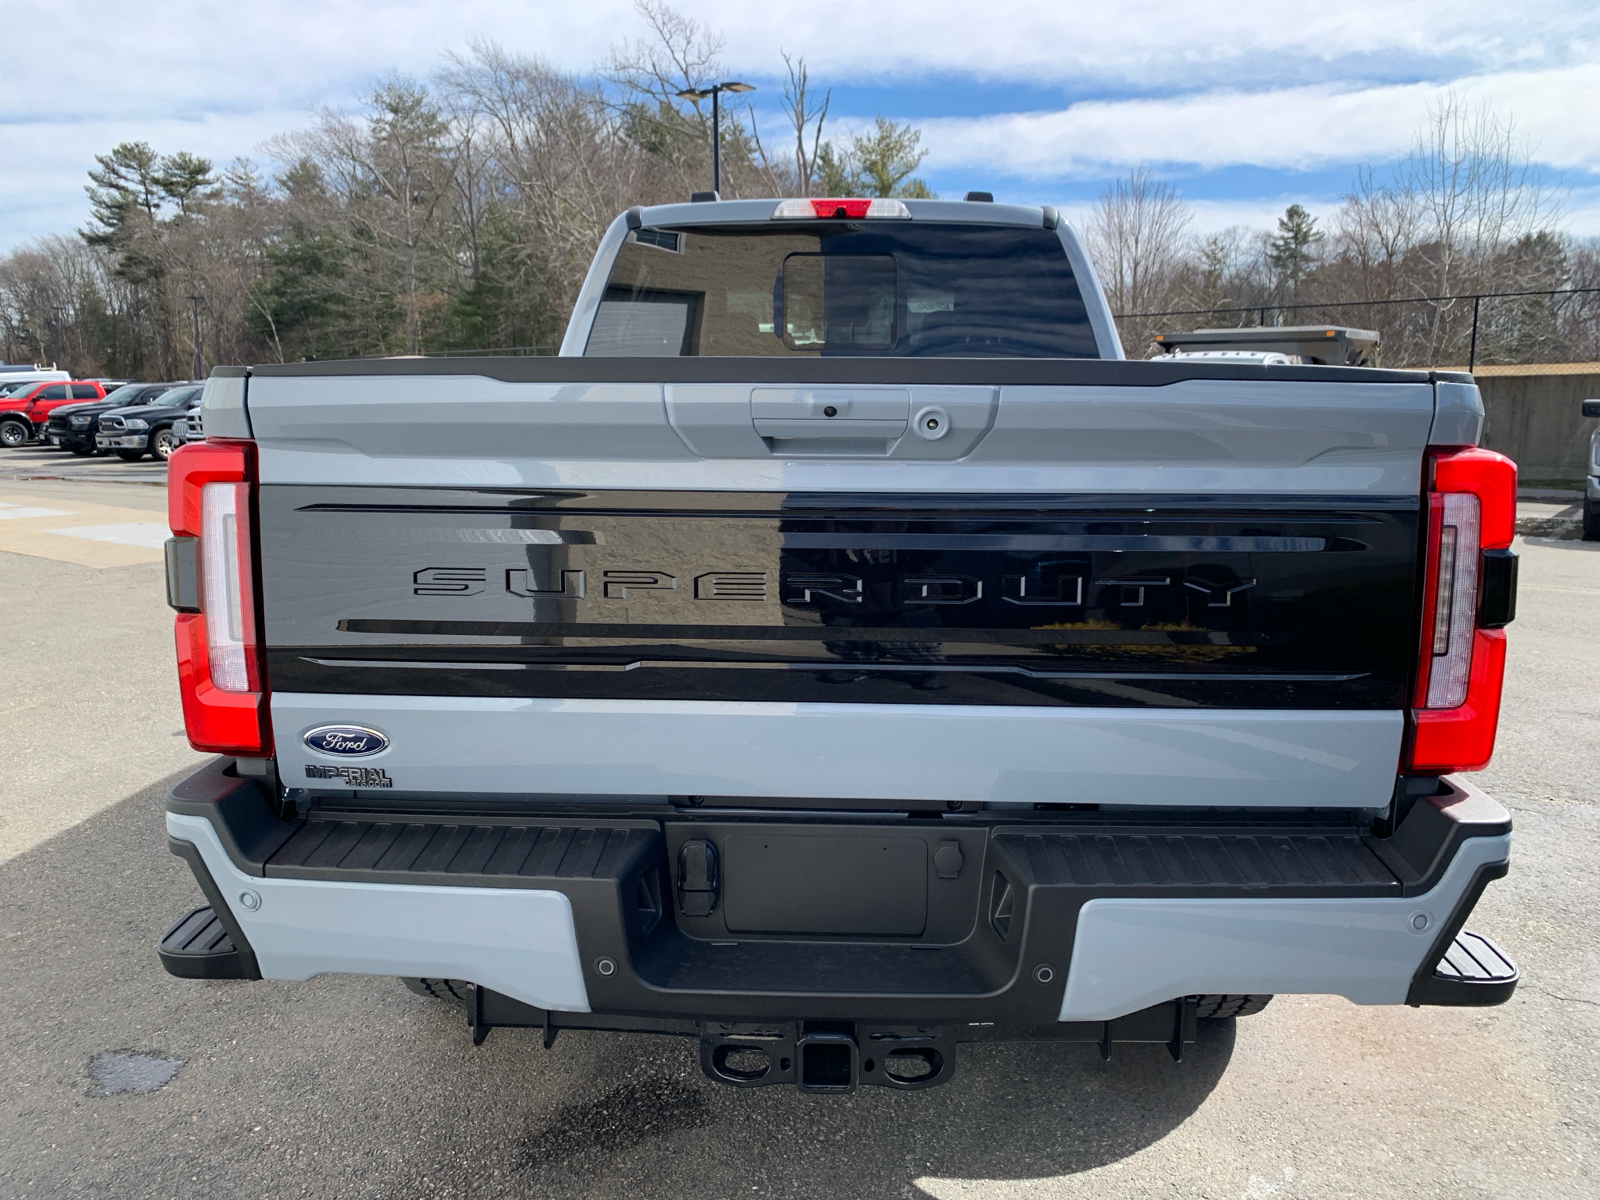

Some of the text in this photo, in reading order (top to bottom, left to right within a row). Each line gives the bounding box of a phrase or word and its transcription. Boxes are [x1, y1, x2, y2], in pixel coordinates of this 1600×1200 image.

[413, 567, 1257, 606] SUPER DUTY
[322, 732, 368, 751] Ford
[305, 765, 391, 781] IMPERIAL
